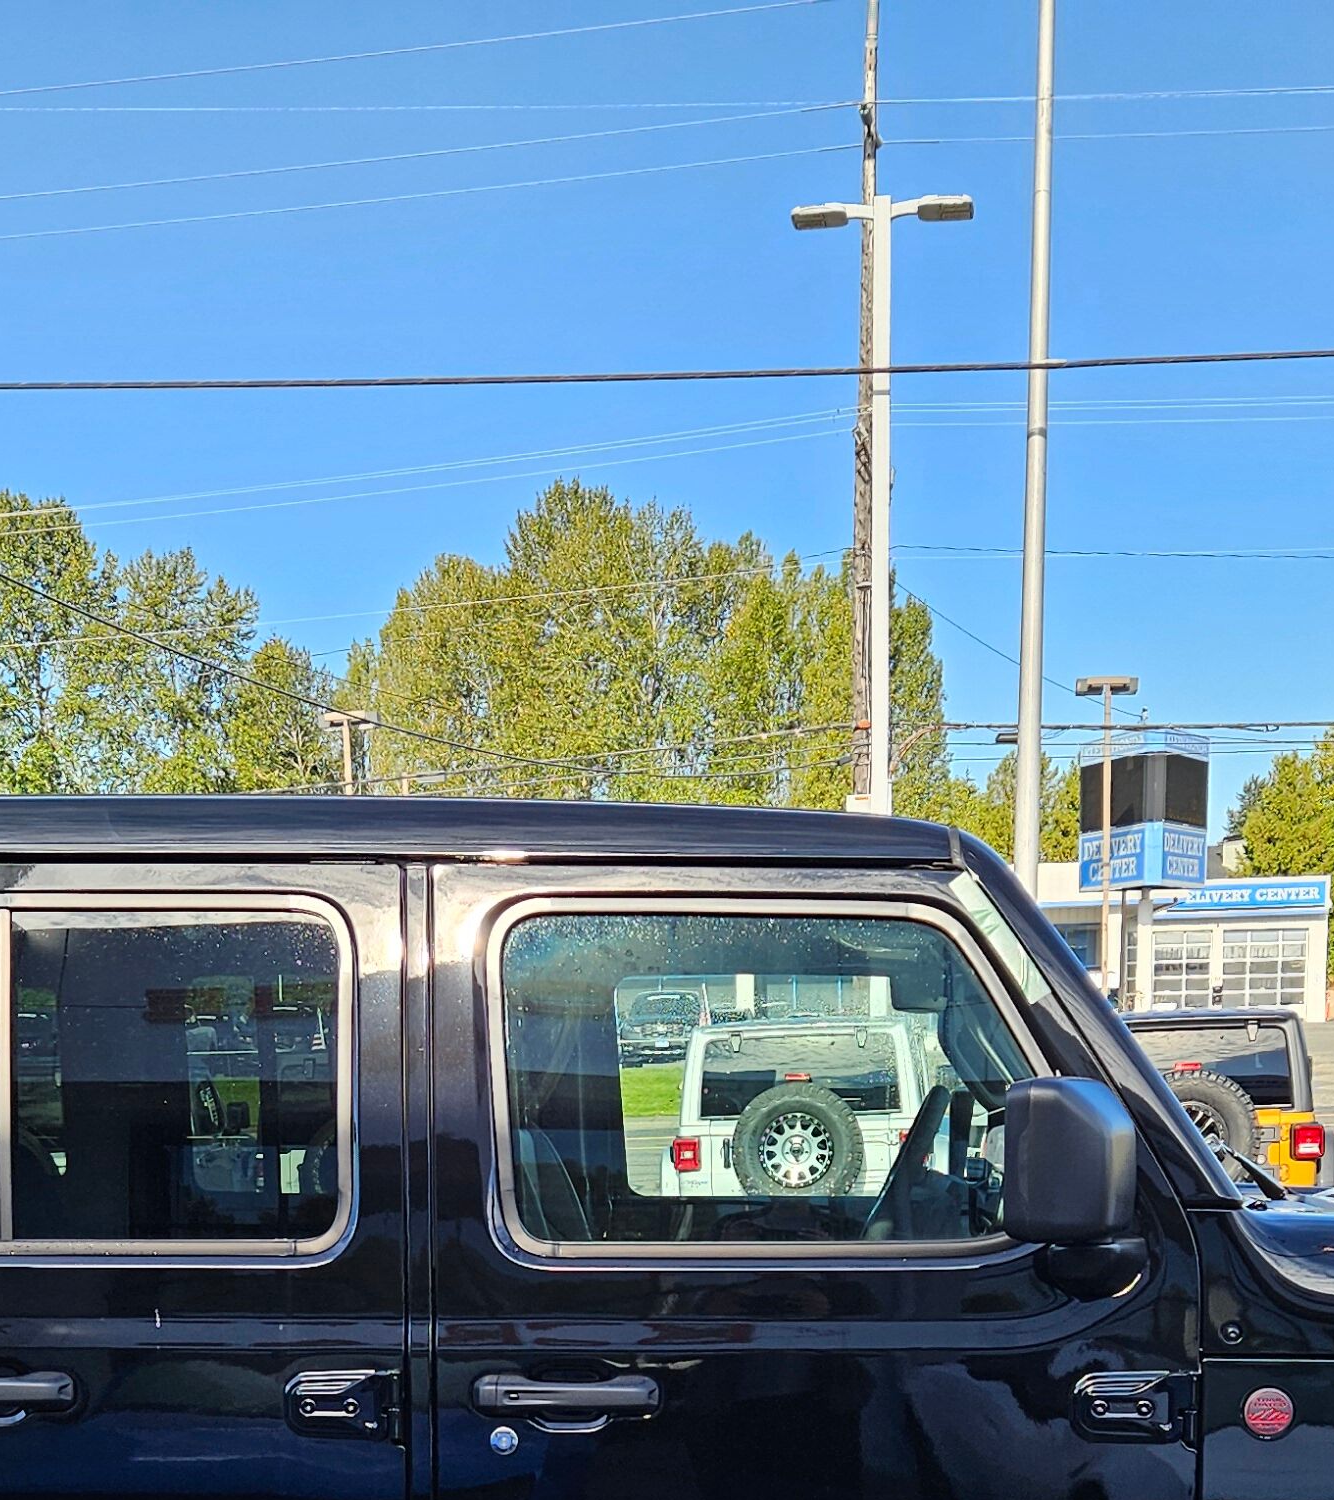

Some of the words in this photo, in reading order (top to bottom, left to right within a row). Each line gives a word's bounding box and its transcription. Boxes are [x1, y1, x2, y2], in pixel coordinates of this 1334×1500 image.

[1084, 834, 1142, 860] DELVERY
[1165, 832, 1204, 857] DELIVERY
[1168, 856, 1200, 878] CENTER
[1186, 888, 1252, 904] ELIVERY
[1255, 886, 1320, 901] CENTER
